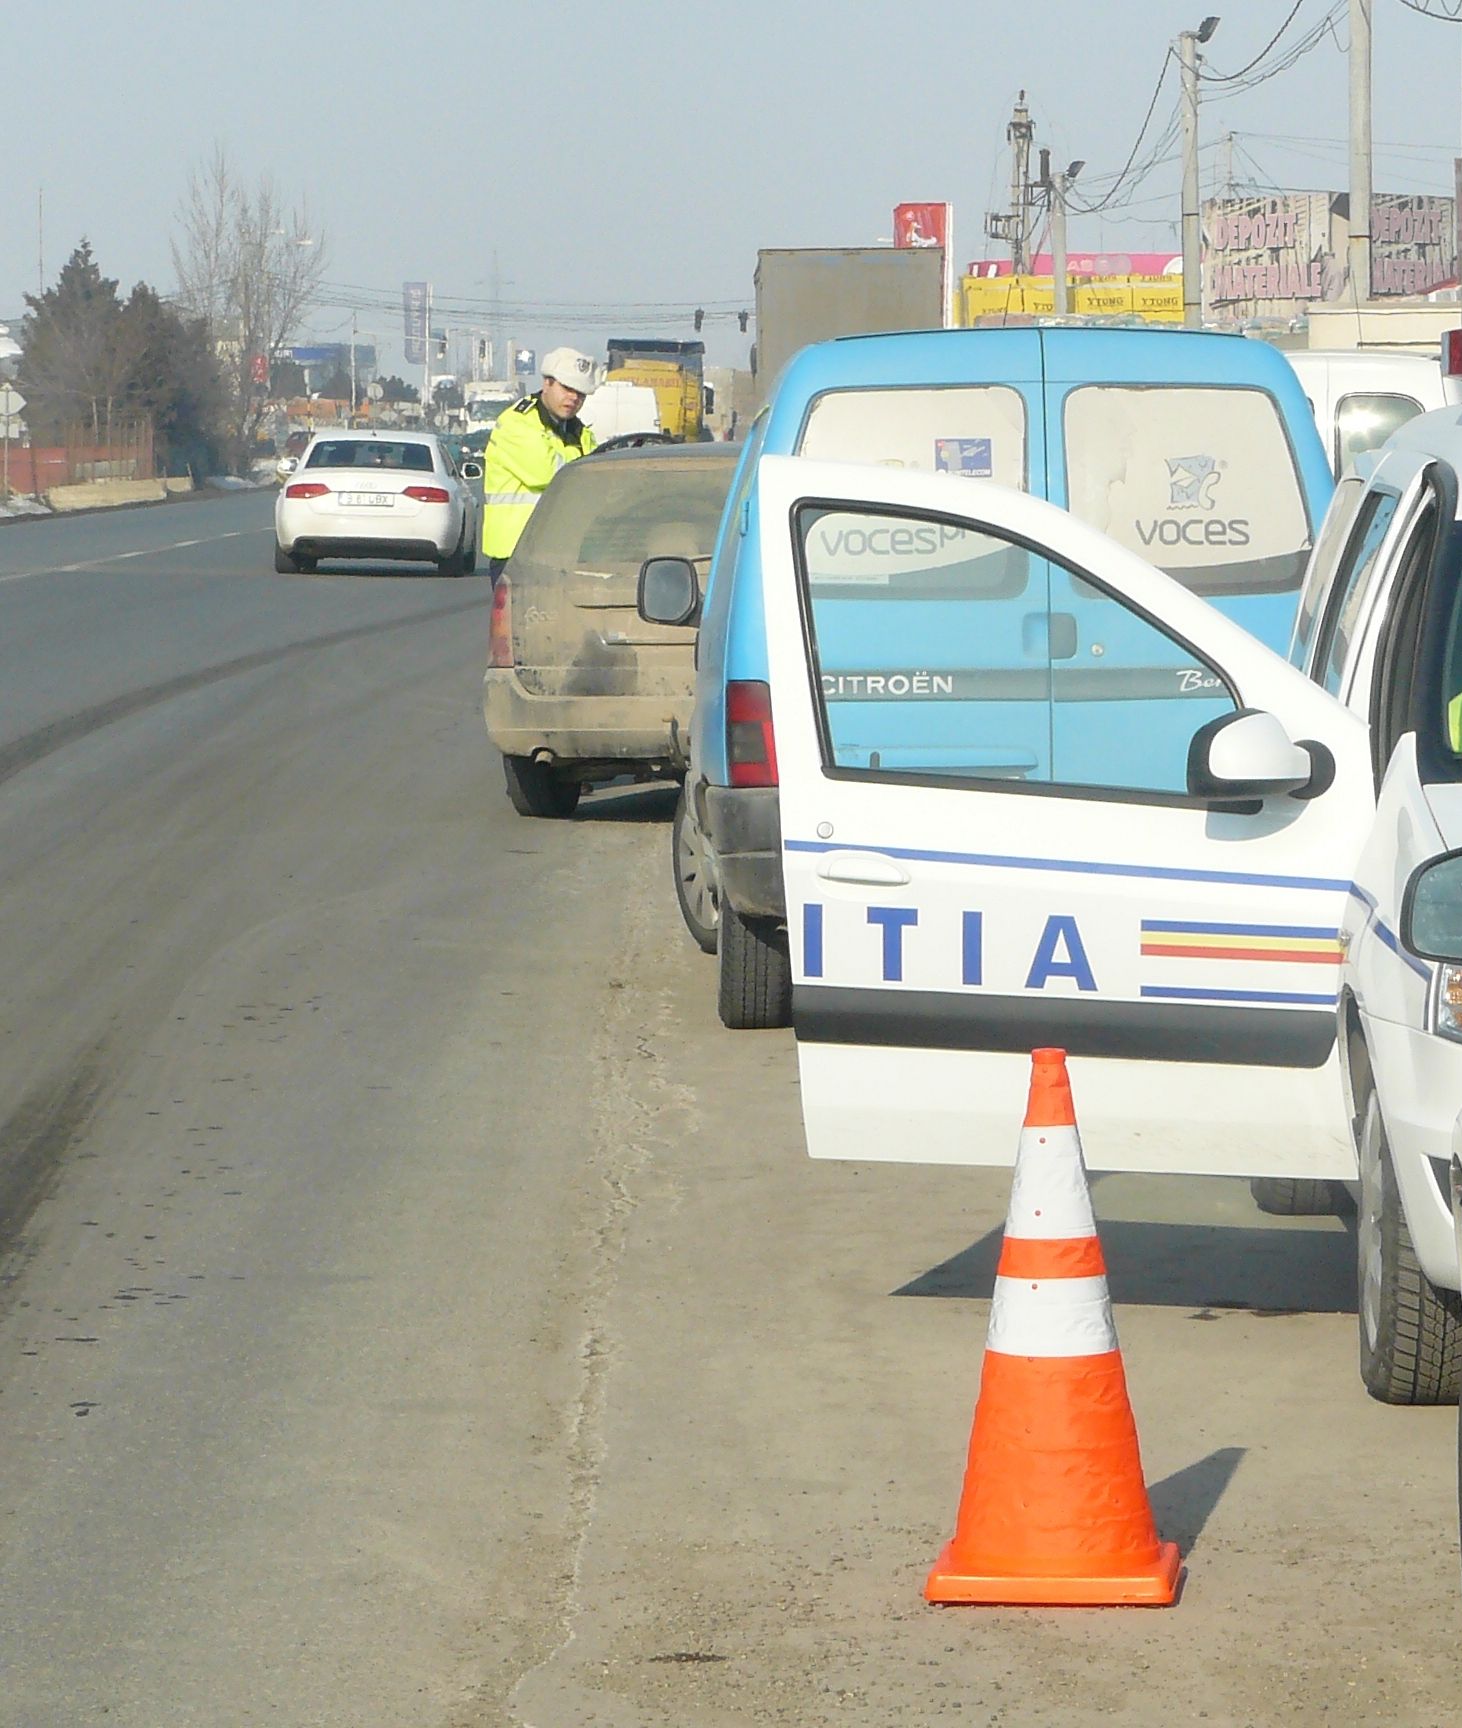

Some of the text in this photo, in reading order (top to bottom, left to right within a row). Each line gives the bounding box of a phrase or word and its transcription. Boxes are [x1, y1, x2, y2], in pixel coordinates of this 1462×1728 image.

[1215, 212, 1298, 250] DEPOZIT
[1211, 261, 1322, 299] MATERIALE
[1087, 297, 1124, 307] YTONG
[1142, 297, 1178, 306] YTONG
[1135, 519, 1250, 546] voces
[821, 671, 953, 695] CITROËN
[803, 903, 1098, 991] ITIA
